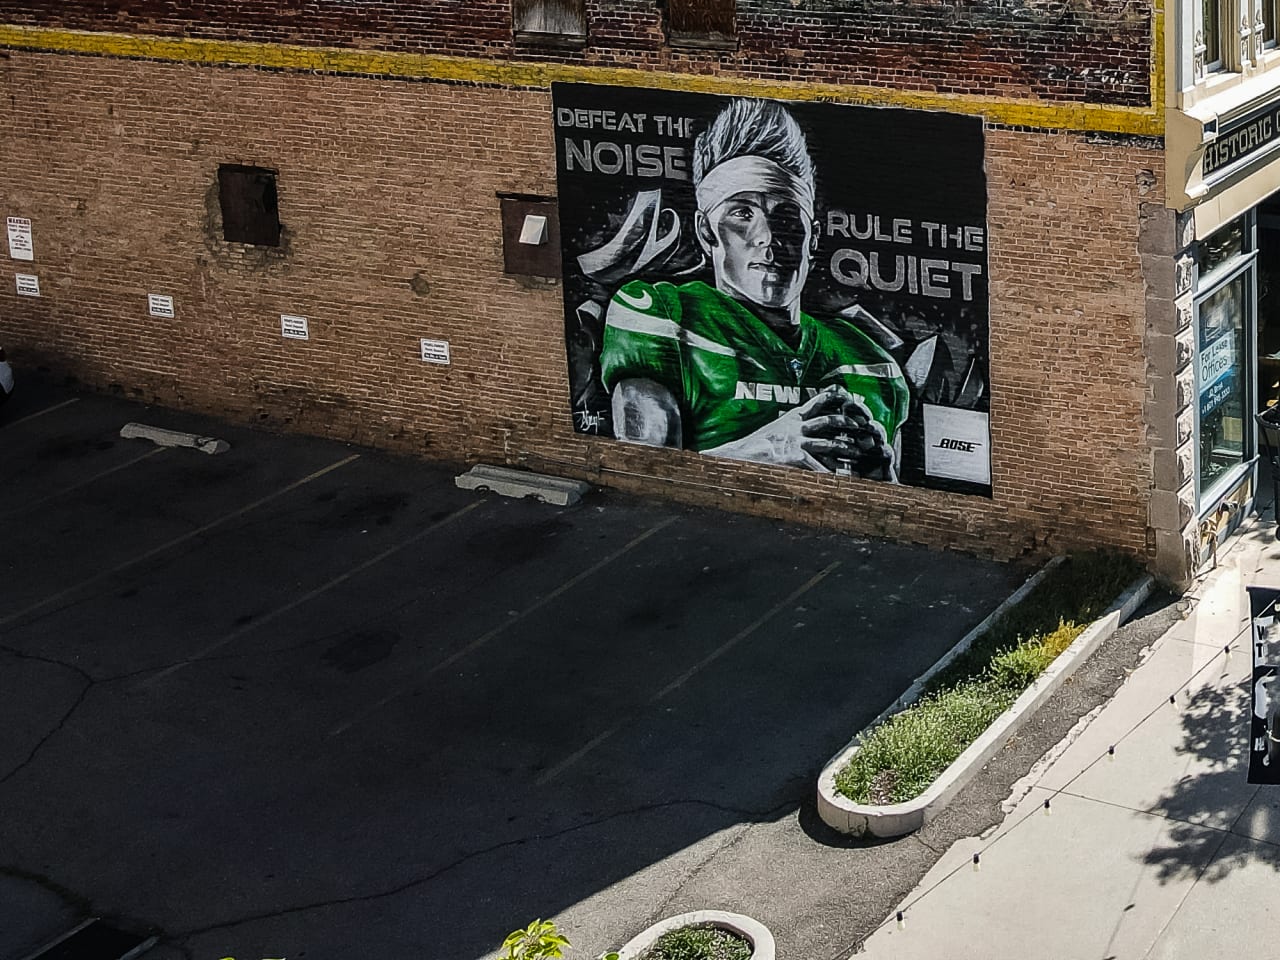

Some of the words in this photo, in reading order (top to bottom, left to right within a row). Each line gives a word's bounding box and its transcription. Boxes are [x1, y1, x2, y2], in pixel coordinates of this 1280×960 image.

[557, 107, 647, 133] DEFEAT
[653, 115, 694, 139] THE
[565, 138, 688, 180] NOISE
[1204, 115, 1273, 173] HISTORIC
[827, 210, 912, 244] RULE
[921, 221, 984, 252] THE
[830, 248, 982, 301] QUIET
[1201, 350, 1211, 366] For
[1211, 339, 1228, 357] Lease
[1202, 355, 1228, 381] Offices
[735, 381, 800, 404] NEW
[932, 438, 982, 453] BOSE
